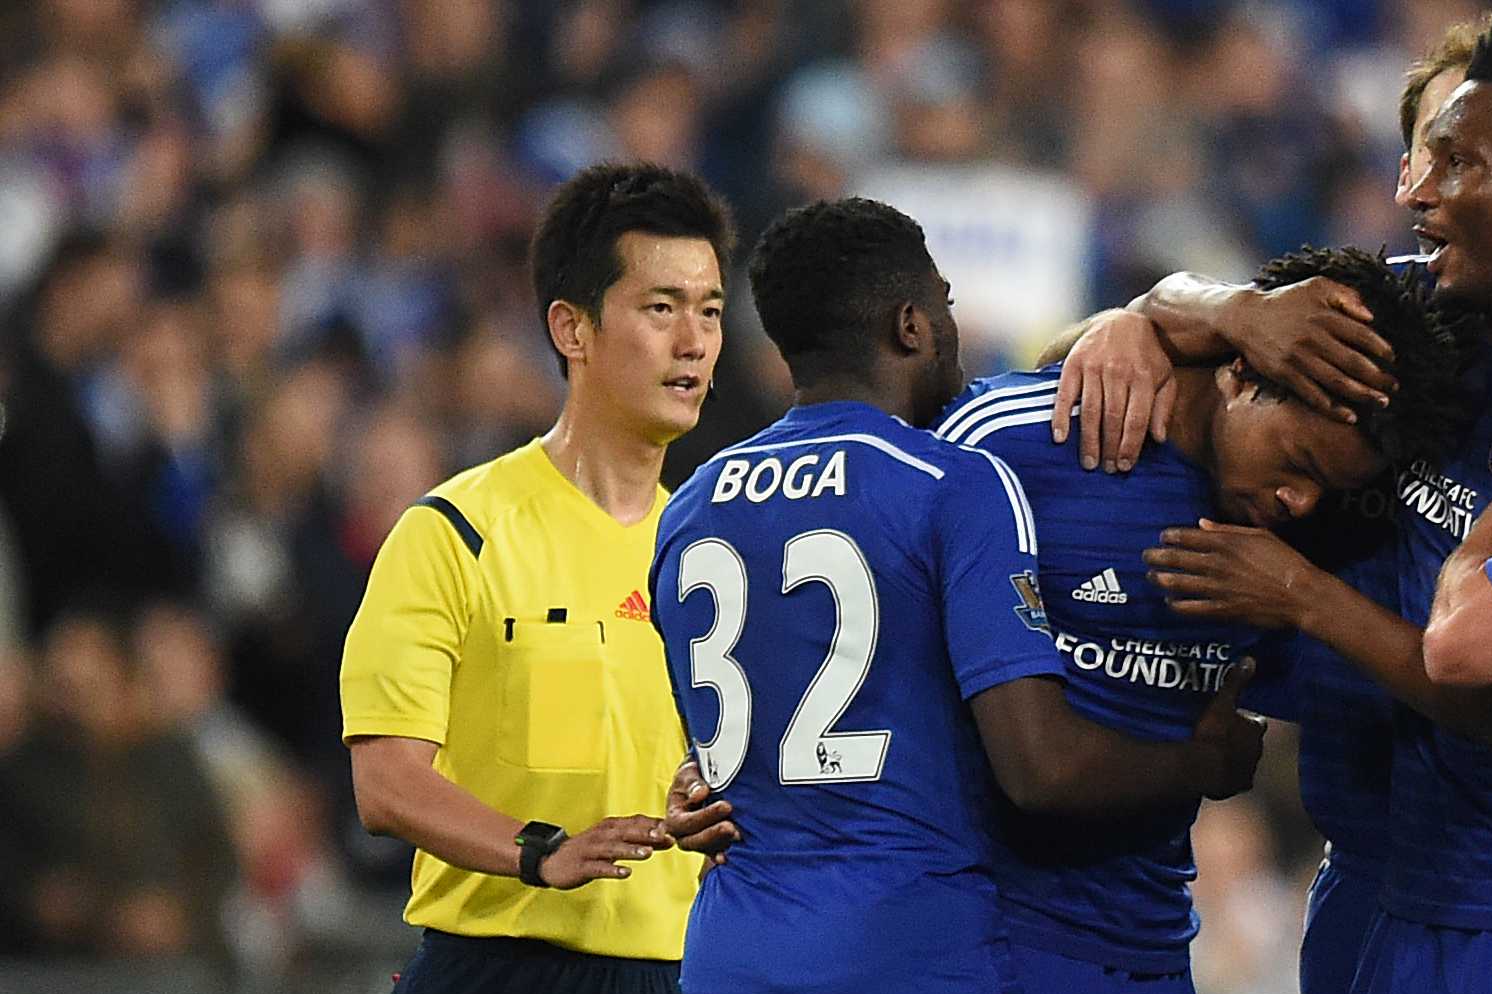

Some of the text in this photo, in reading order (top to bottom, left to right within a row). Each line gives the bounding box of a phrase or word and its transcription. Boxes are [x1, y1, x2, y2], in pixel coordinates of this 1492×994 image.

[710, 450, 847, 503] BOGA
[1071, 589, 1127, 604] adidas
[678, 528, 892, 792] 32
[1055, 632, 1235, 692] FOUNDATI
[1205, 642, 1230, 661] FC
